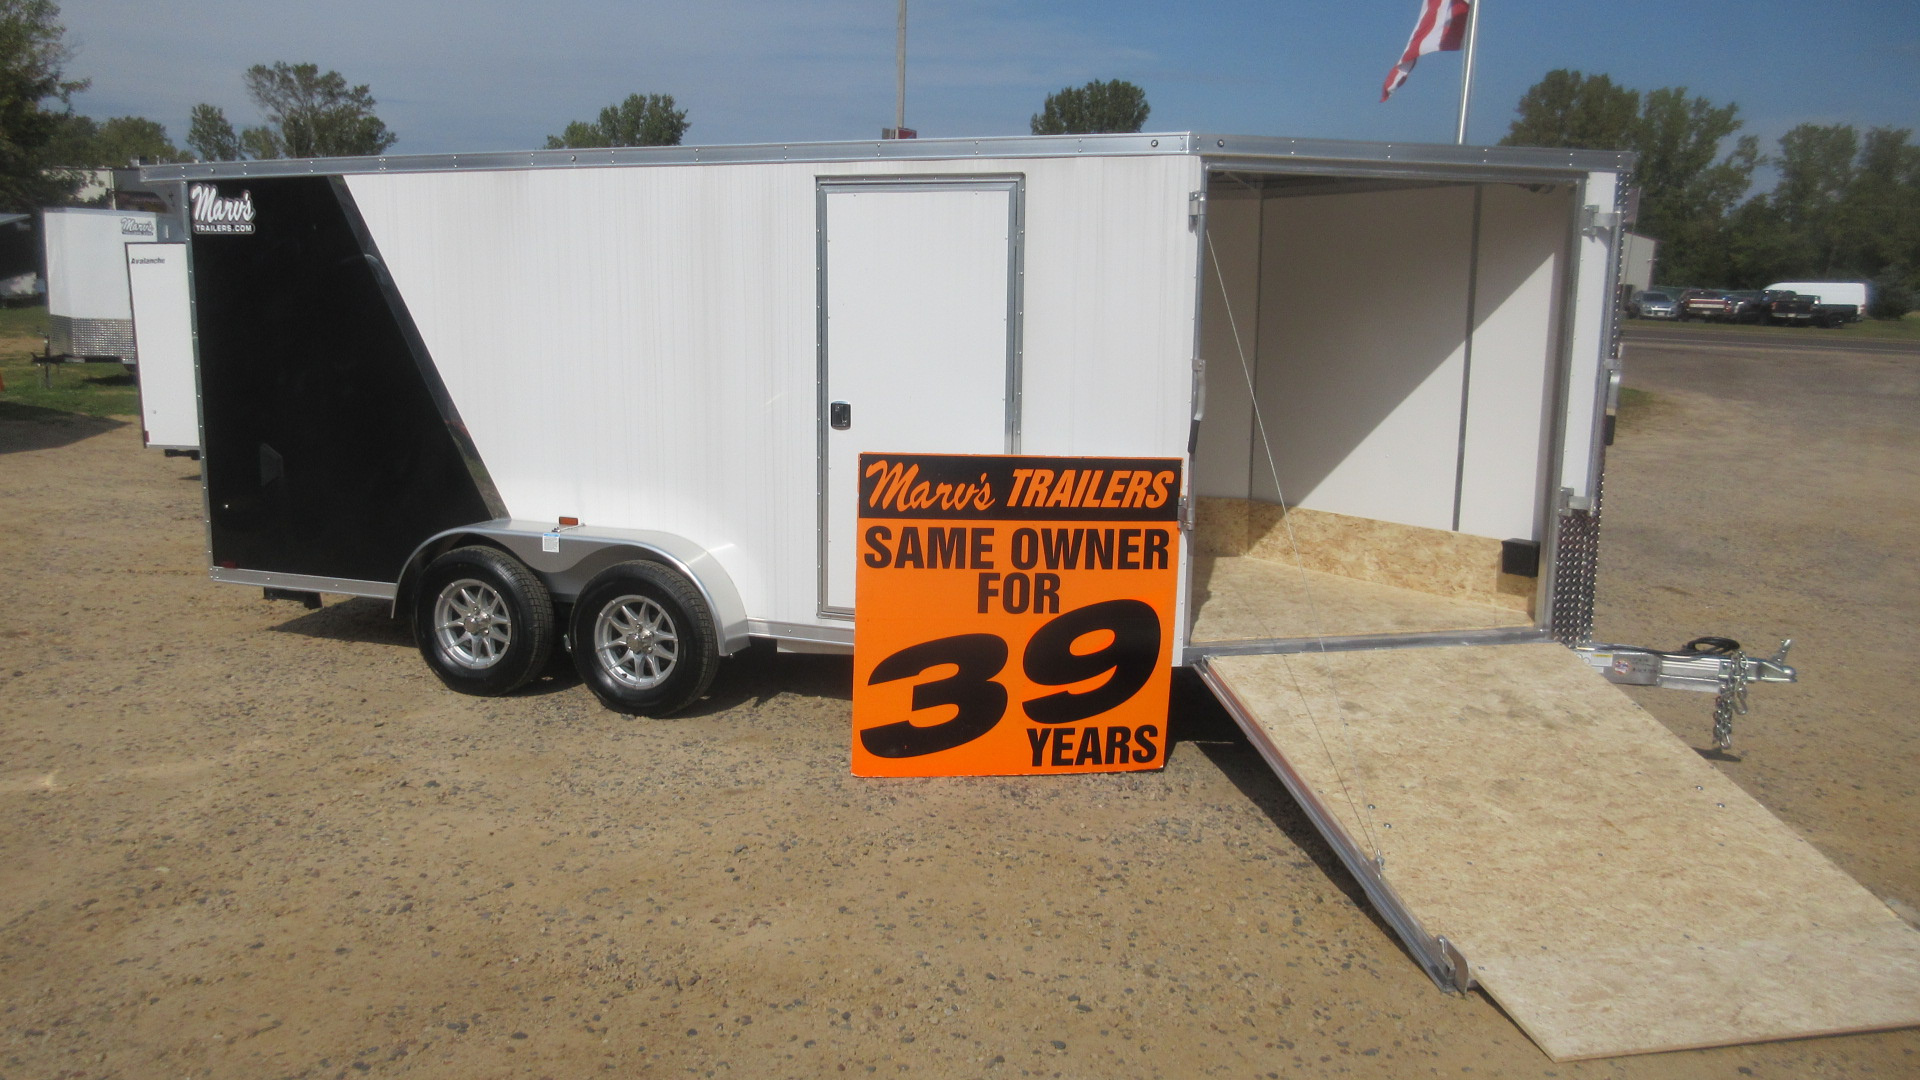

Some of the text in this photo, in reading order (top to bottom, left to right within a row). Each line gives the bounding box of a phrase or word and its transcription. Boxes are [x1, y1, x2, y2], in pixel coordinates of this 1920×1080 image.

[191, 185, 254, 223] Marv's
[195, 224, 252, 232] TRAILERS.COM
[865, 459, 1175, 512] Marv's TRAILERS
[864, 525, 1170, 570] SAME OWNER
[977, 572, 1060, 614] FOR
[860, 598, 1161, 758] 39
[1026, 724, 1158, 767] YEARS
